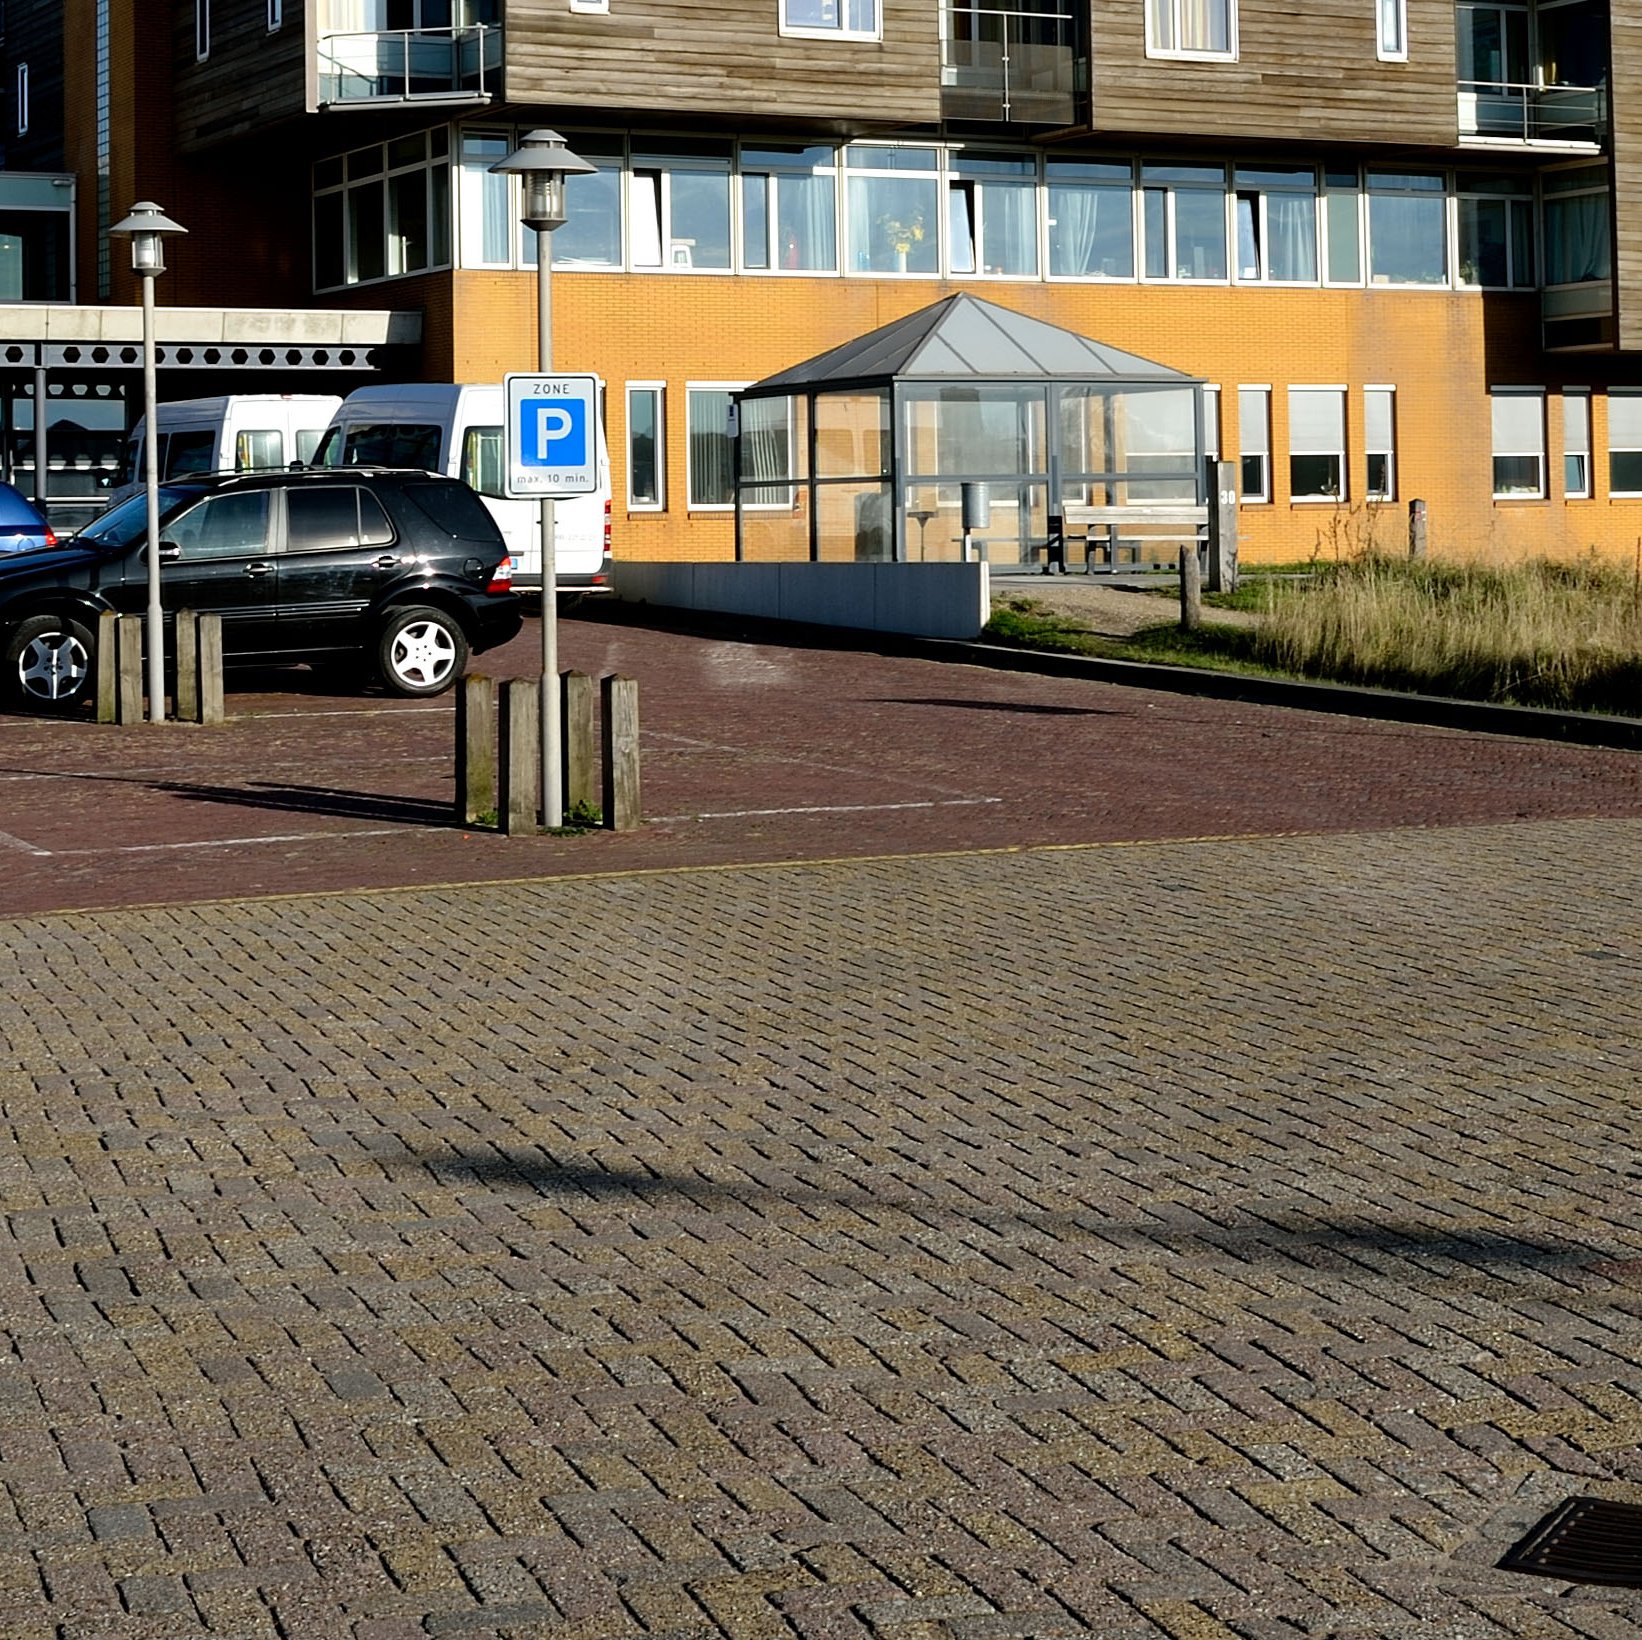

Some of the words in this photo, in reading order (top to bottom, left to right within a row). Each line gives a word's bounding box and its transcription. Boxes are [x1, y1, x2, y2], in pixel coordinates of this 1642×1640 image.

[533, 383, 570, 395] ZONE
[537, 407, 573, 460] P
[517, 475, 543, 484] max.
[547, 474, 560, 483] 10
[565, 473, 589, 483] min.
[1220, 490, 1236, 505] 30
